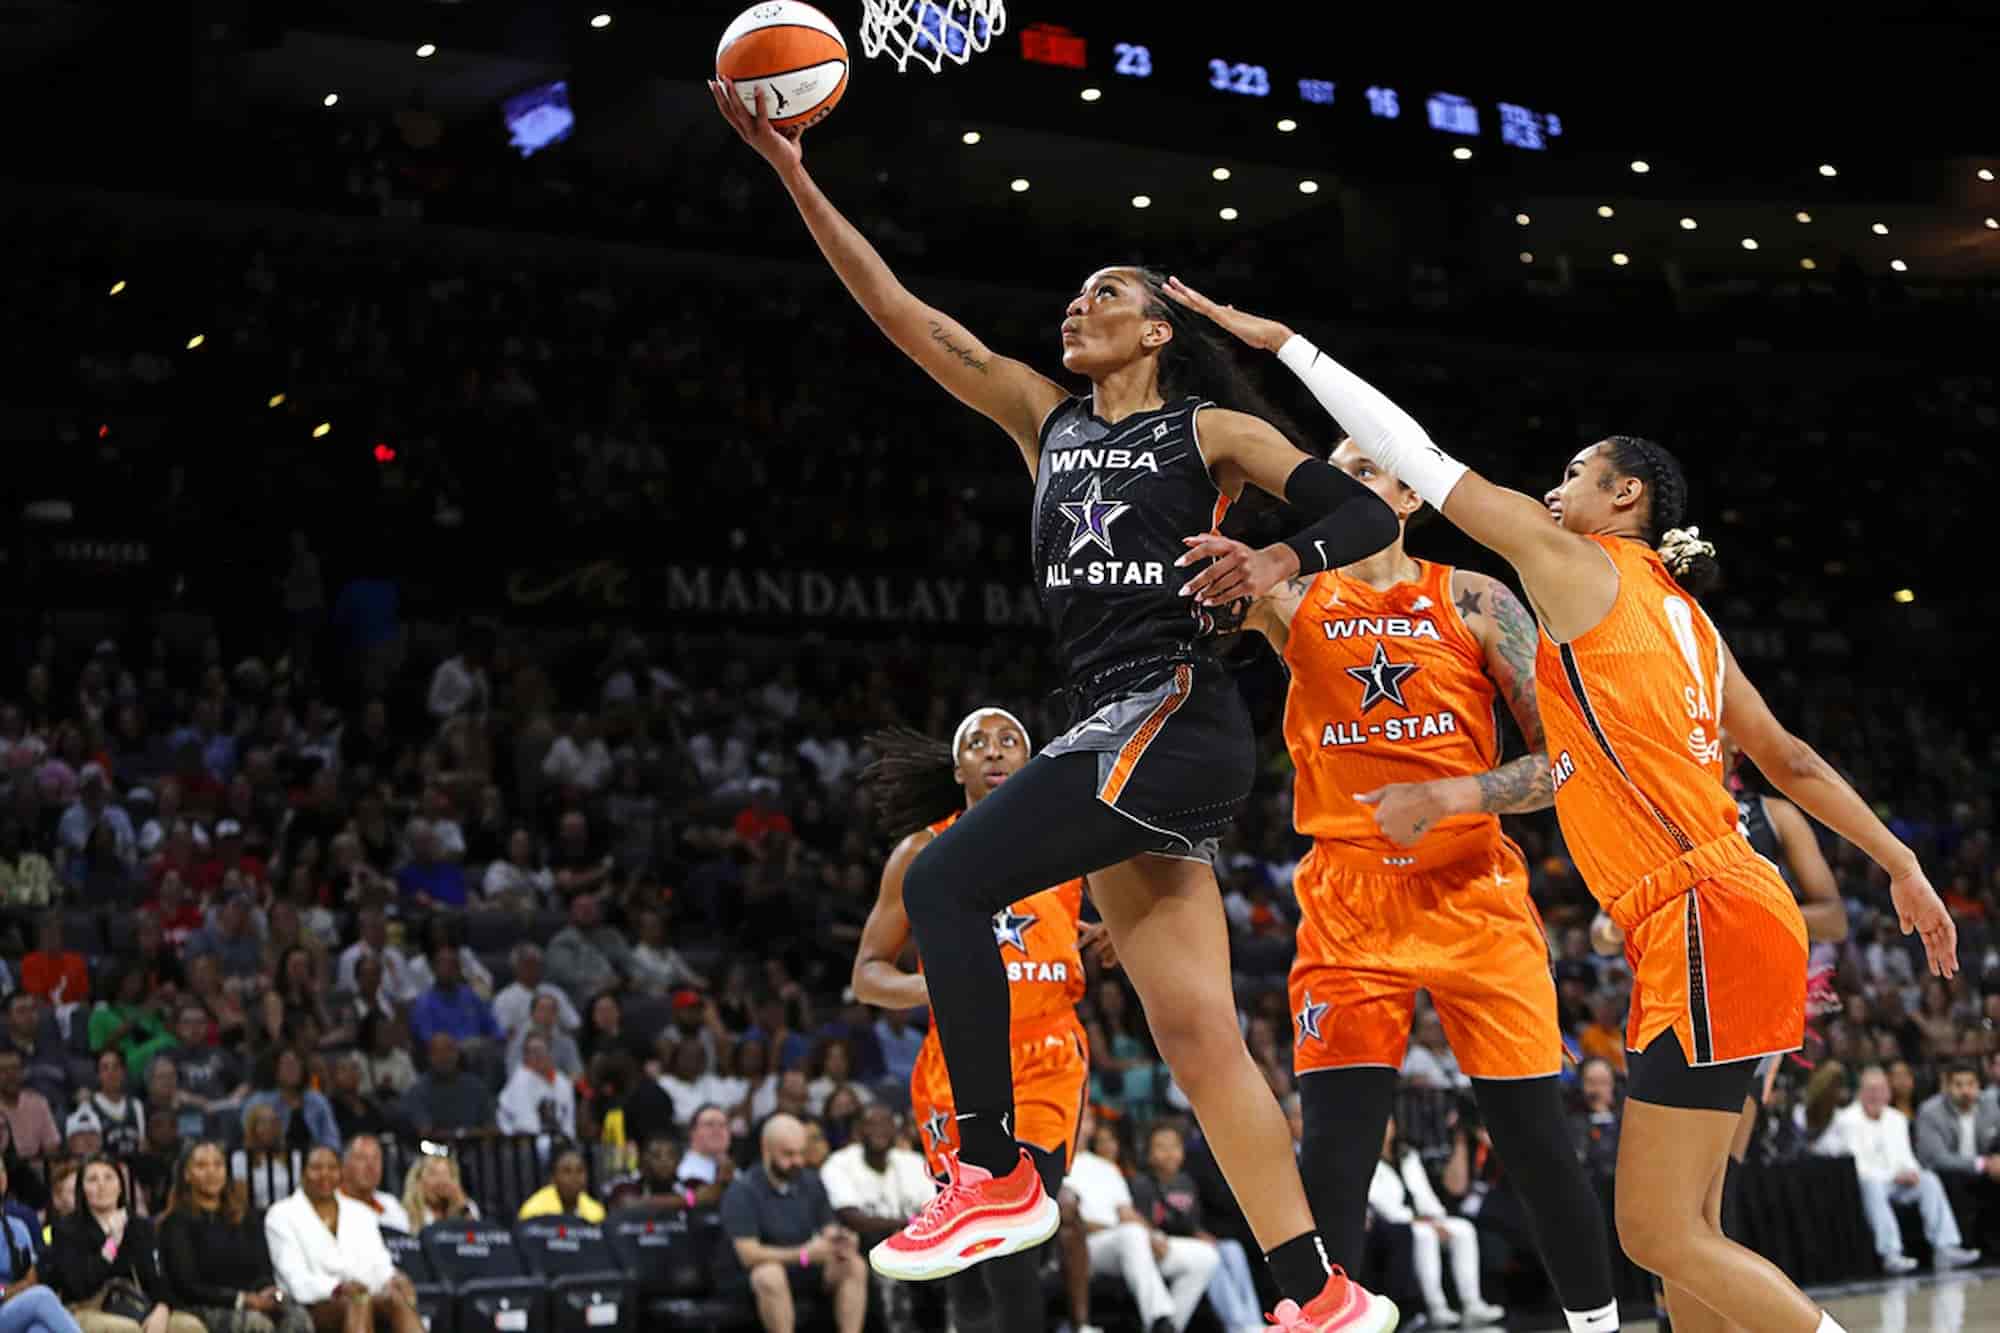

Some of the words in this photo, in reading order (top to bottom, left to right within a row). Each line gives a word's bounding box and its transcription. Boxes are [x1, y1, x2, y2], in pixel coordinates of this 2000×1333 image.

[1113, 42, 1152, 77] 23
[1050, 448, 1159, 473] WNBA
[1045, 560, 1165, 588] ALL-STAR
[666, 564, 964, 622] MANDALAY
[983, 584, 1043, 624] BA
[1323, 617, 1441, 640] WNBA
[1321, 711, 1457, 746] ALL-STAR
